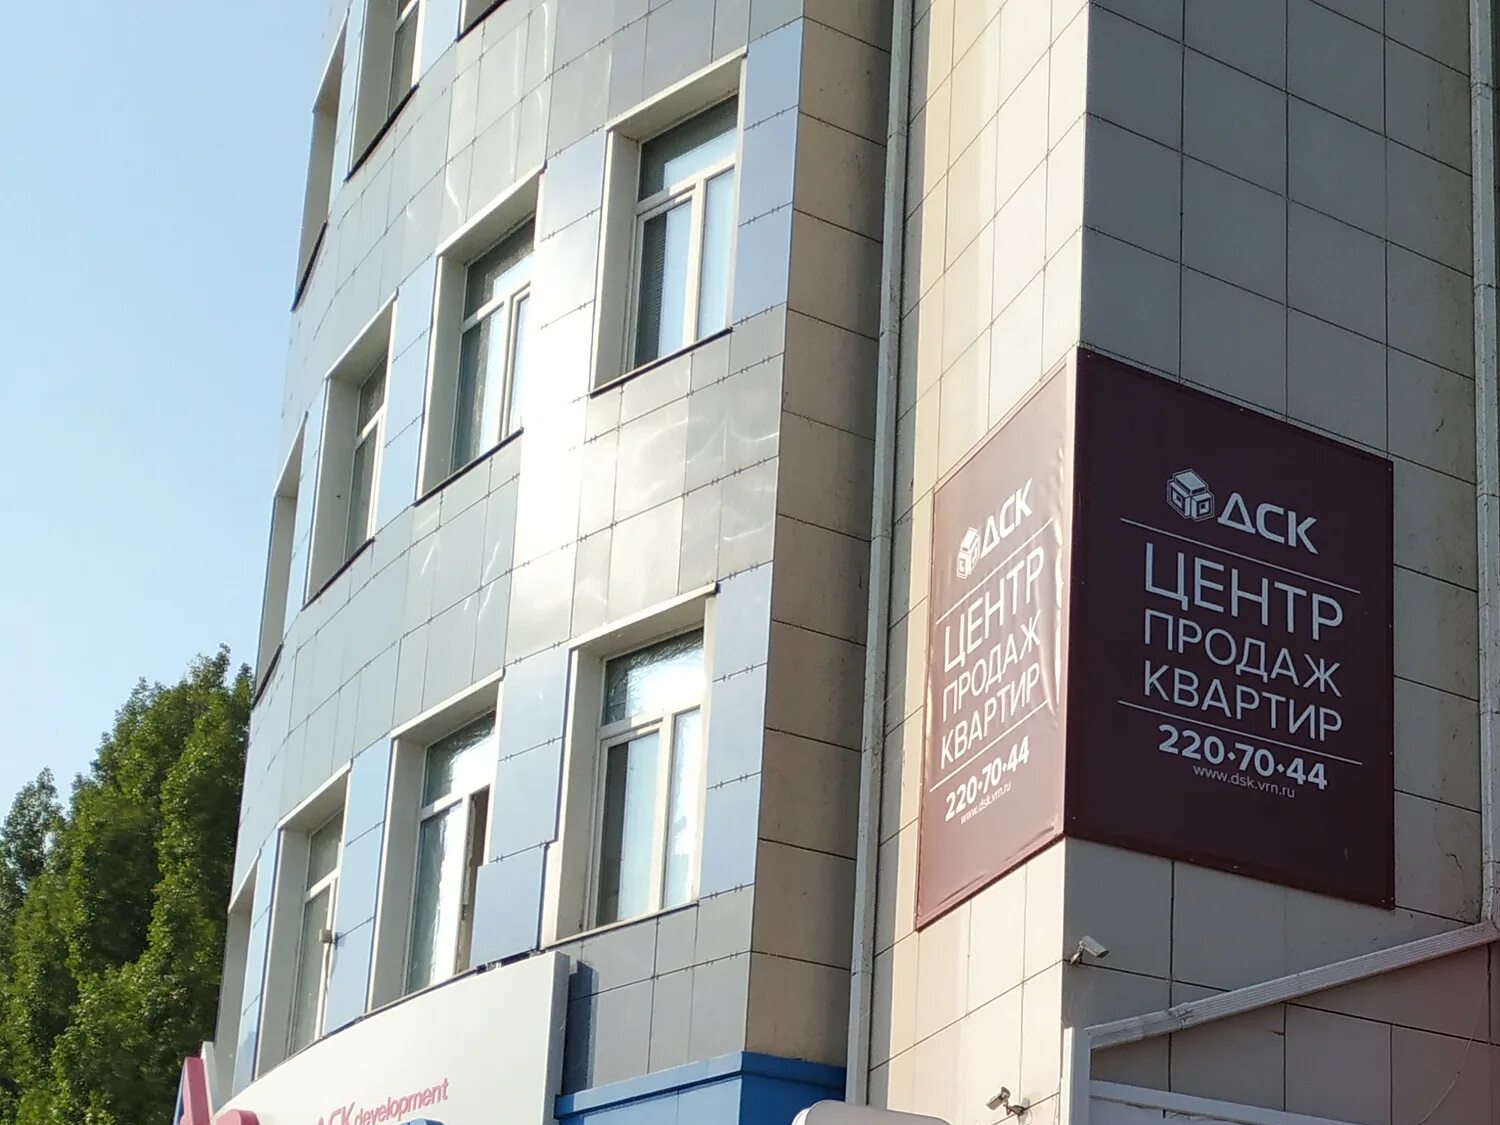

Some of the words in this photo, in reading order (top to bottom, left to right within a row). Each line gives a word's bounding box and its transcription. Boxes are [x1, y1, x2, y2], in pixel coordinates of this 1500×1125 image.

[979, 477, 1033, 558] ДСК
[1217, 491, 1320, 556] ДСК
[943, 546, 1045, 672] ЦЕНТР
[1143, 542, 1344, 641] ЦЕНТР
[942, 609, 1040, 723] ПРОДАЖ
[1143, 608, 1342, 697] ПРОДАЖ
[940, 662, 1040, 770] КВАРТИР
[1143, 659, 1343, 742] КВАРТИР
[1193, 762, 1296, 799] www.dsk.vrn.ru
